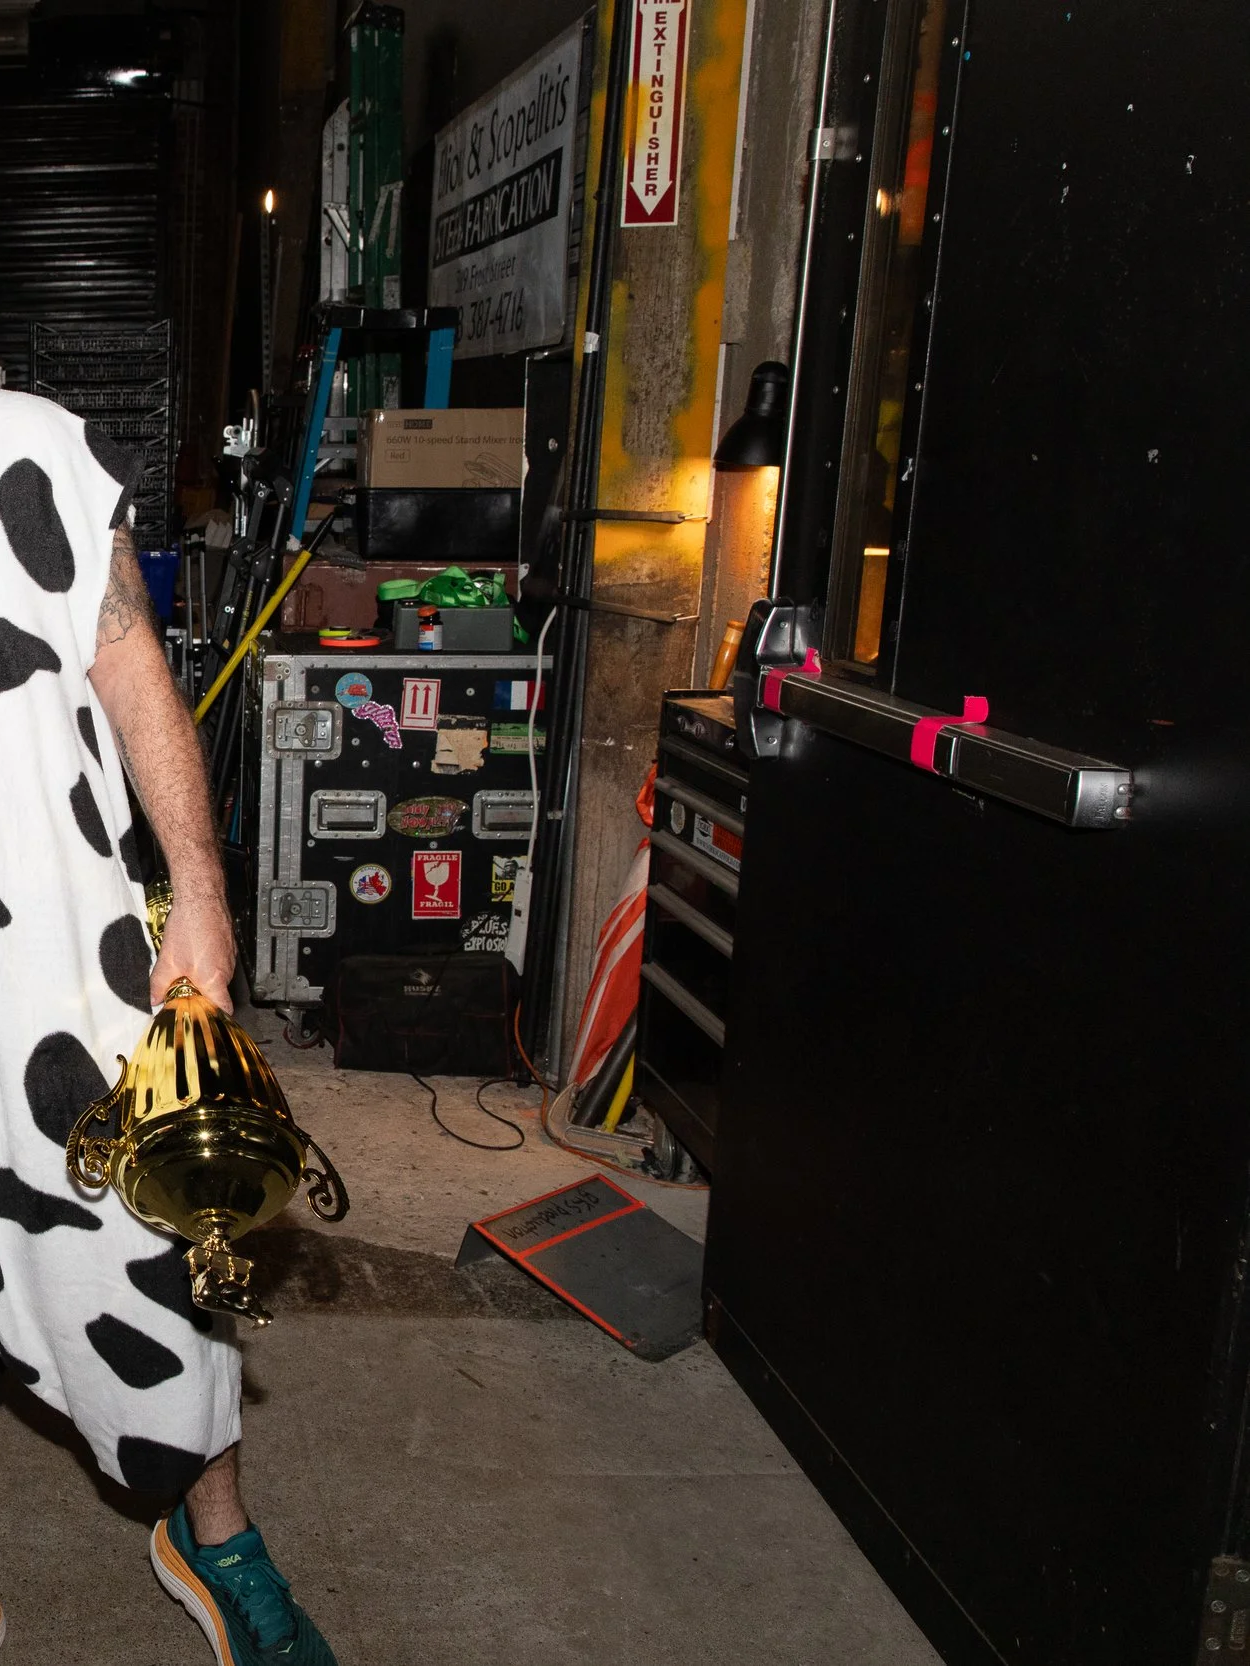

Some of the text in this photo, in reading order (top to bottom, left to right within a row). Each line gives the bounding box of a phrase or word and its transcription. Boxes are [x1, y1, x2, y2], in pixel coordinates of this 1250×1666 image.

[644, 11, 667, 196] EXTINGUISHER
[467, 122, 484, 180] &
[488, 64, 570, 170] Scopelitis
[464, 159, 556, 248] FABRICATION
[467, 288, 524, 340] 387-4716
[386, 436, 412, 444] 660W
[414, 435, 453, 446] 10-speed
[455, 435, 481, 444] Stand
[482, 435, 506, 444] Mixer
[390, 452, 406, 460] Red
[417, 854, 458, 862] FRAGILE
[494, 881, 507, 891] GO
[213, 1553, 243, 1568] HOKA
